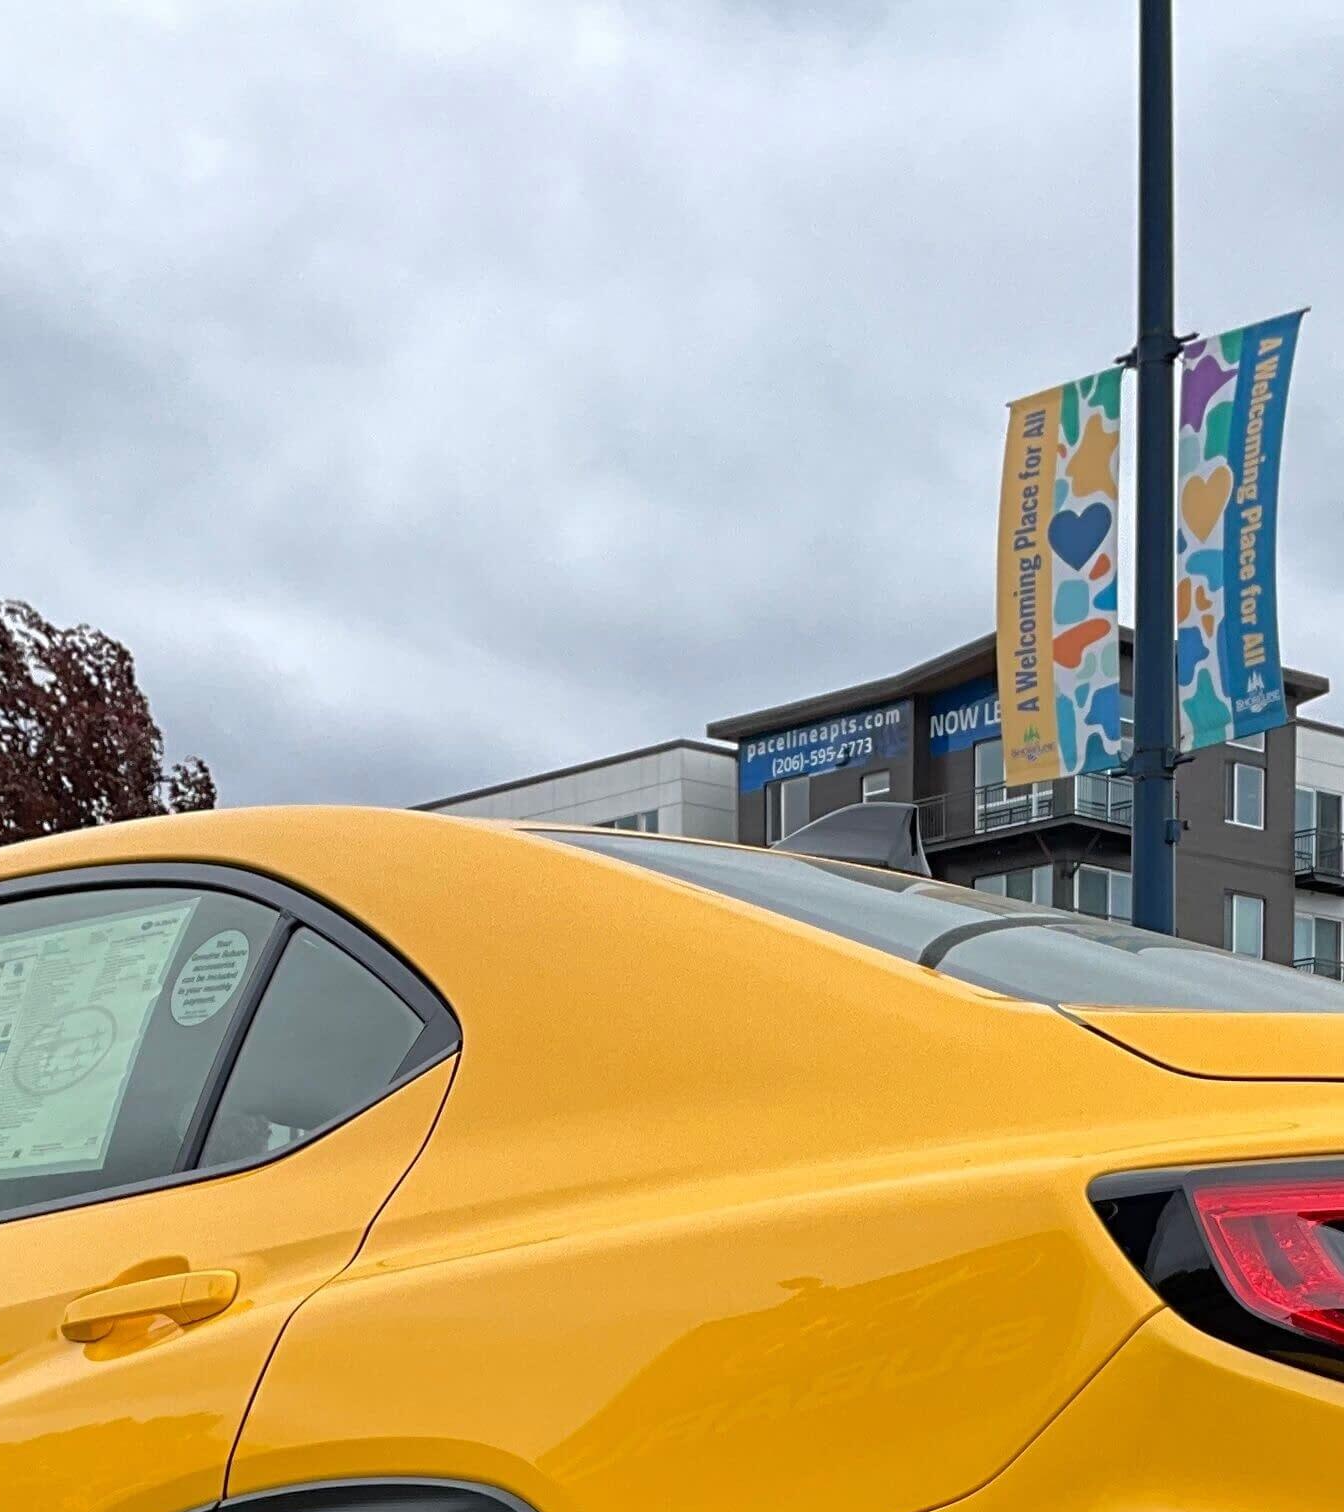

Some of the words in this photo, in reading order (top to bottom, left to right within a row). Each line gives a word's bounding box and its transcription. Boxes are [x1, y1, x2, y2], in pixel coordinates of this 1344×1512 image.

[1258, 337, 1283, 356] A
[1023, 409, 1046, 438] All
[1237, 356, 1279, 504] Welcoming
[1018, 447, 1042, 480] for
[1014, 484, 1039, 551] Place
[1240, 505, 1262, 581] Place
[1240, 584, 1262, 624] for
[1013, 553, 1042, 693] Welcoming
[1242, 633, 1266, 667] All
[930, 706, 979, 738] NOW
[1017, 696, 1040, 712] A
[746, 707, 901, 763] pacelineapts.com
